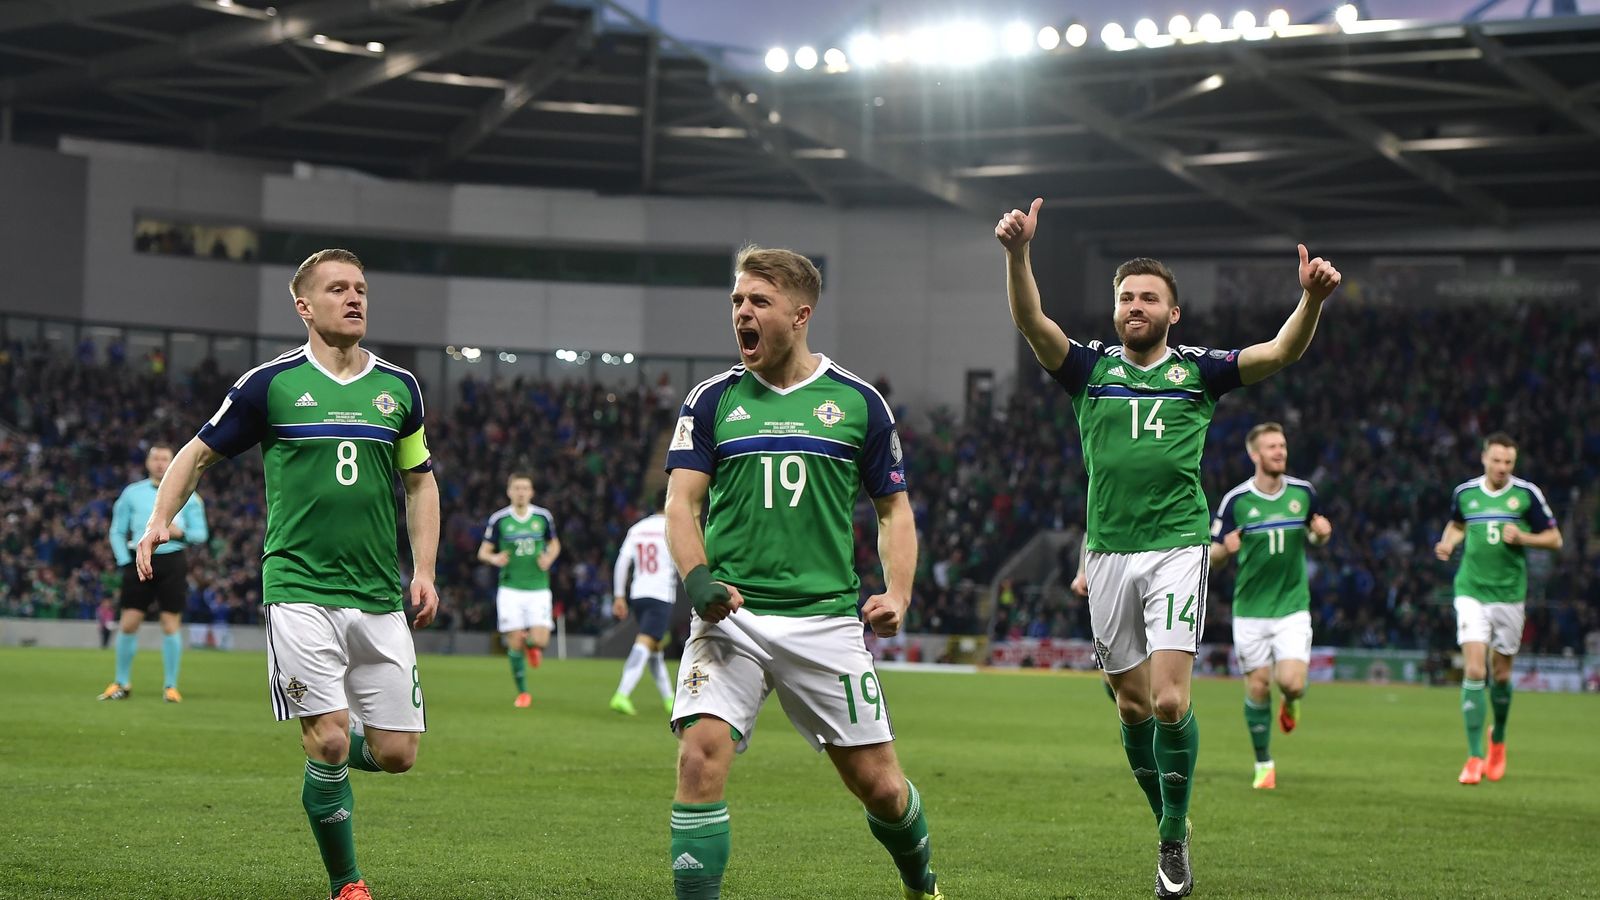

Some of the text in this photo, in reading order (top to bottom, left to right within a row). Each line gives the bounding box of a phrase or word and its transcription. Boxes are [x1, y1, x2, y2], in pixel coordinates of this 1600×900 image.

[725, 414, 751, 423] adidas
[1129, 400, 1165, 439] 14
[335, 441, 359, 486] 8
[760, 455, 807, 509] 19
[1268, 528, 1285, 555] 11
[1487, 521, 1500, 545] 5
[636, 543, 658, 575] 18
[1166, 593, 1196, 632] 14
[412, 665, 422, 709] 8
[839, 671, 881, 724] 19
